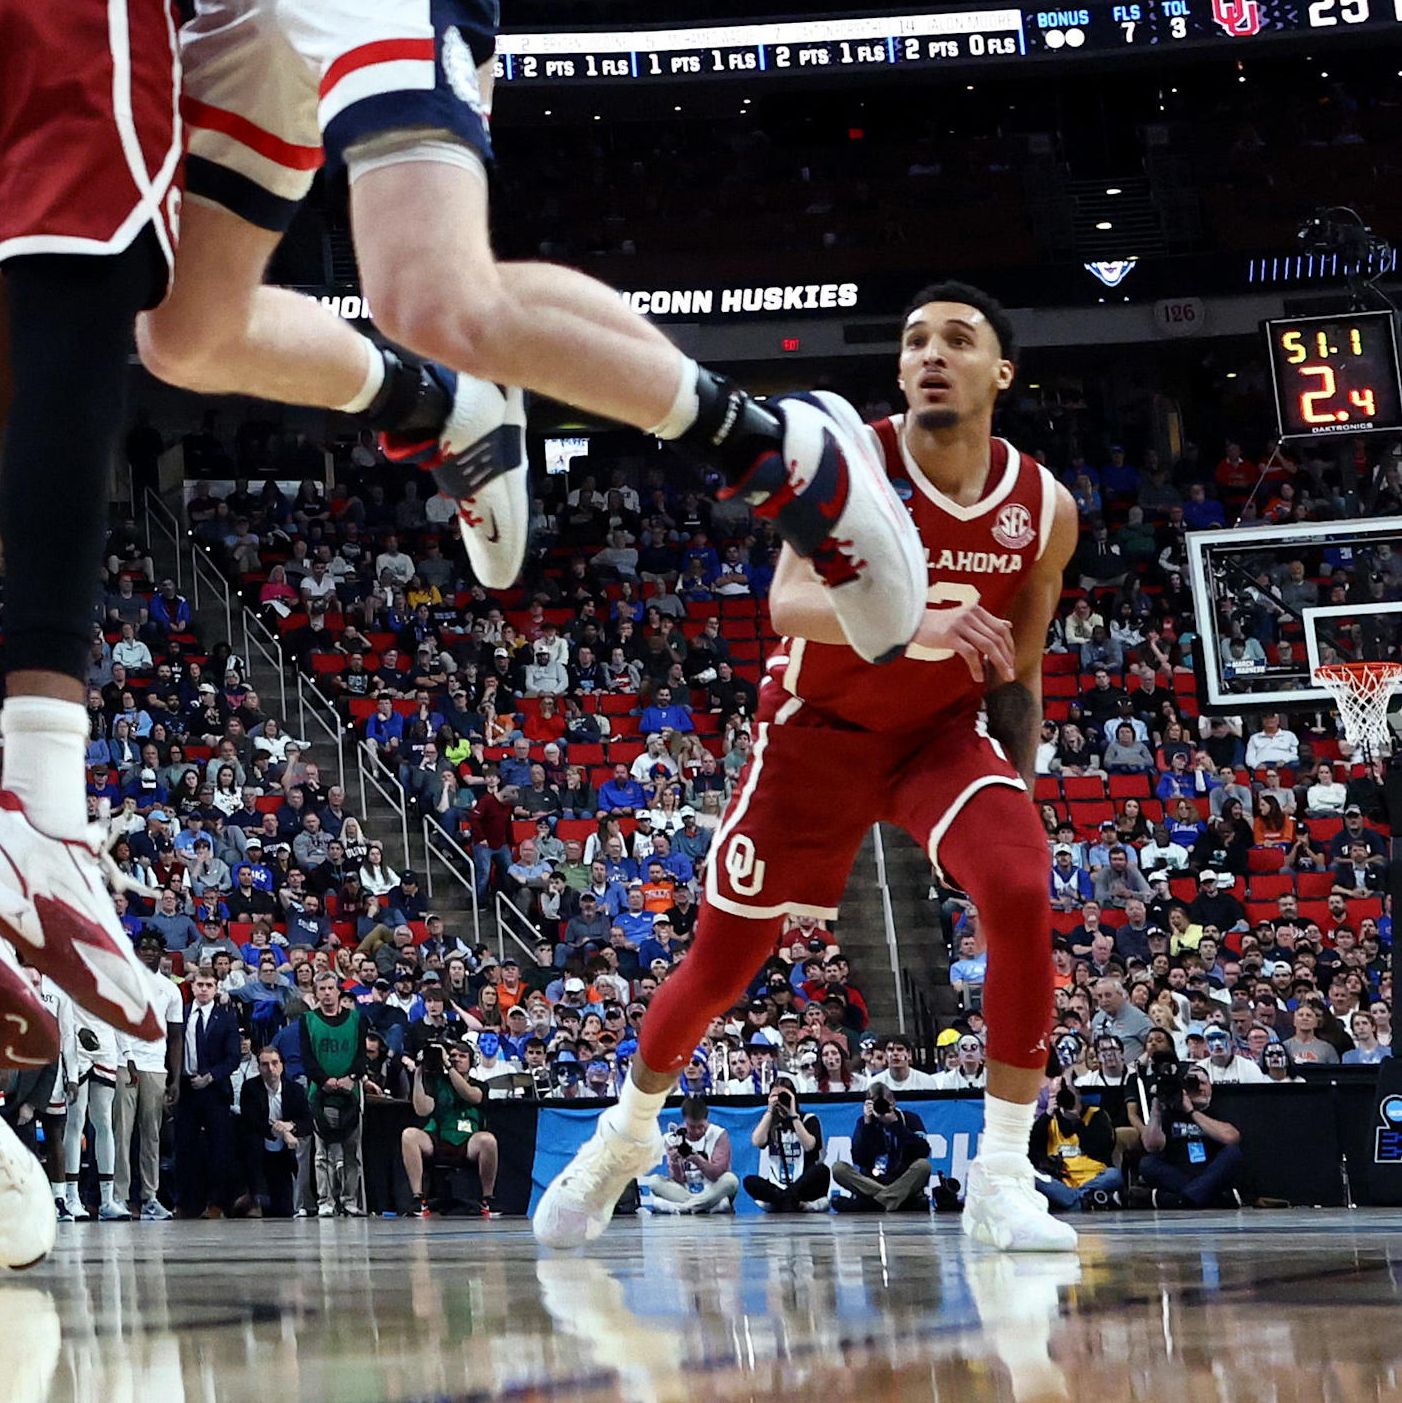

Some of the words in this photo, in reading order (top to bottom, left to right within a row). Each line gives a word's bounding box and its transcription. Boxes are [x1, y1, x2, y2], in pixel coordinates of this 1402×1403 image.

[1037, 9, 1090, 29] BONUS
[1113, 4, 1141, 21] FLS
[1161, 0, 1191, 18] TOL
[1120, 22, 1137, 43] 7
[1169, 16, 1188, 39] 3
[775, 46, 791, 68] 2
[798, 48, 829, 66] PTS
[839, 42, 853, 64] 1
[857, 45, 886, 63] FLS
[905, 38, 920, 60] 2
[927, 40, 959, 59] PTS
[968, 34, 985, 56] 0
[987, 36, 1016, 55] FLS
[523, 56, 538, 78] 2
[545, 61, 575, 78] PTS
[585, 55, 598, 76] 1
[601, 59, 629, 76] FLS
[649, 53, 662, 75] 1
[671, 56, 701, 73] PTS
[711, 49, 725, 71] 1
[728, 53, 756, 71] FLS
[720, 283, 858, 312] HUSKIES
[1164, 304, 1196, 323] 126
[1282, 328, 1363, 364] 51.1
[1299, 365, 1376, 423] 2.4
[1311, 422, 1374, 434] DAKTRONICS
[1000, 507, 1029, 538] SEC
[924, 547, 1023, 574] LAHOMA
[727, 833, 766, 896] OU
